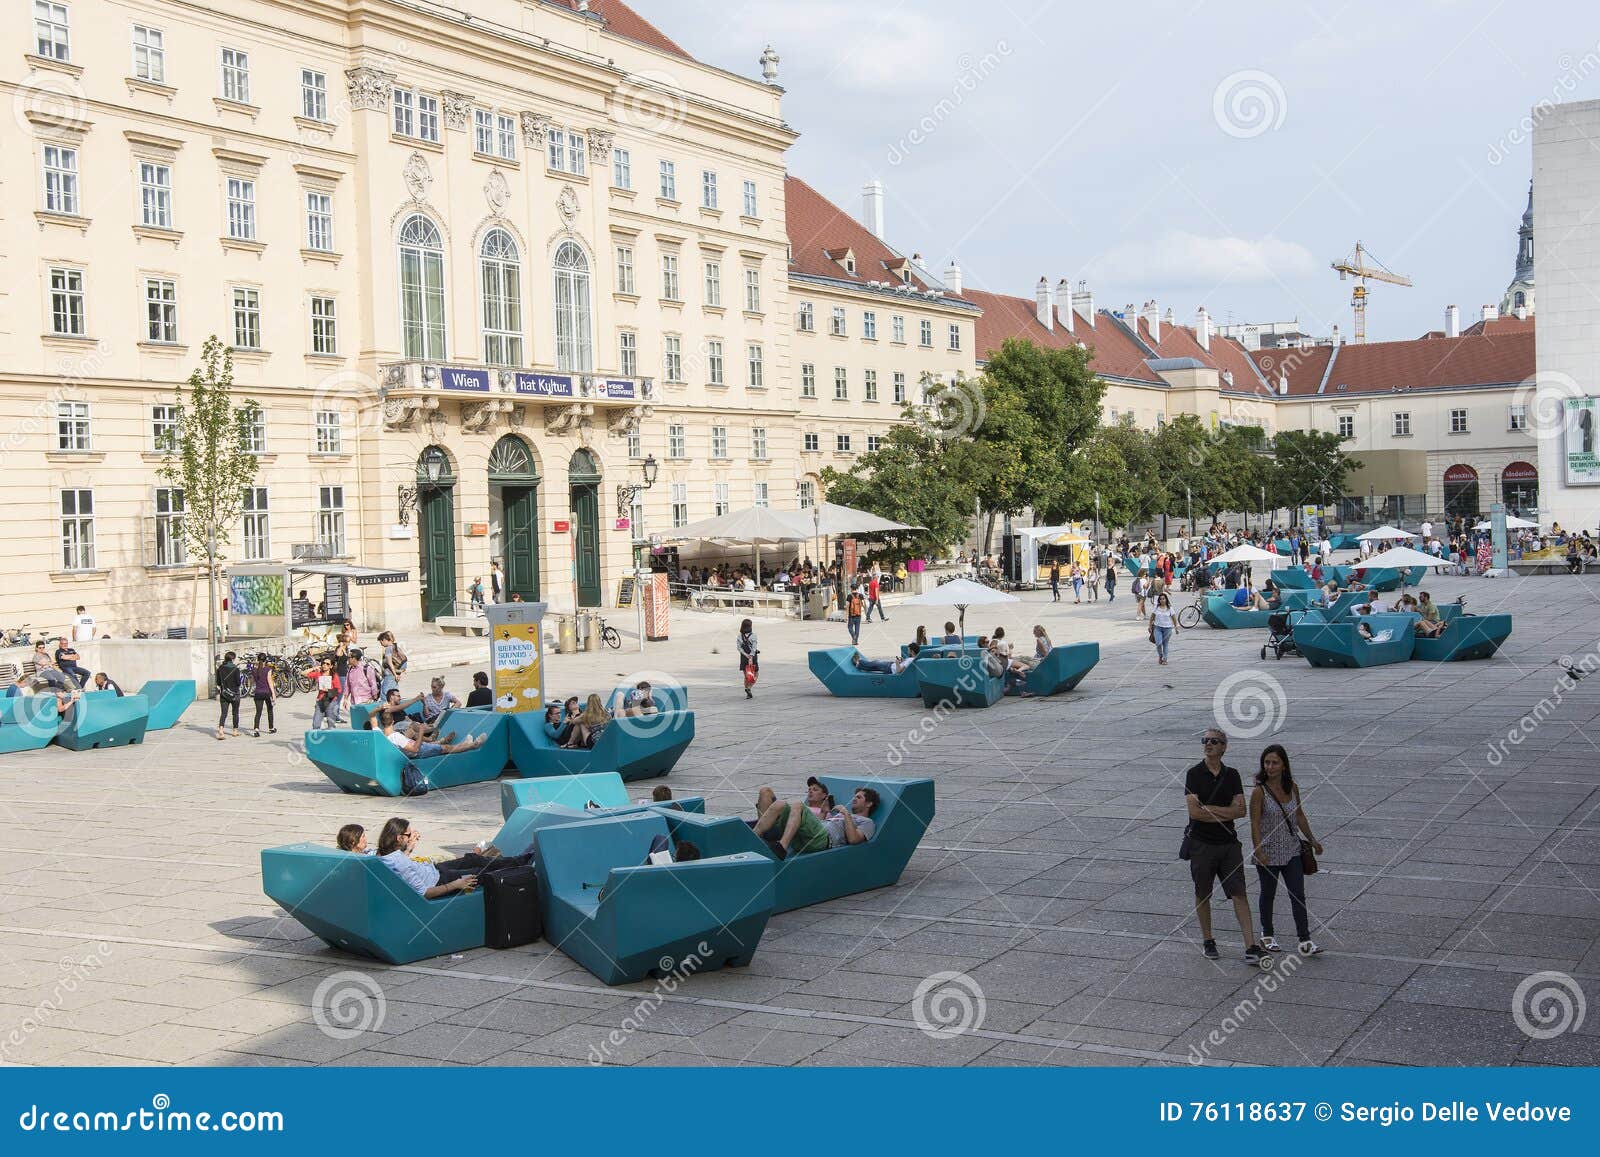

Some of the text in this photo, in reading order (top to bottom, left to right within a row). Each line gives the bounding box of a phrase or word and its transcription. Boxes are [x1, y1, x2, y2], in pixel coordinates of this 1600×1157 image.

[451, 373, 480, 388] Wien
[519, 376, 569, 394] hat Kultur.
[497, 644, 533, 652] WEEKEND
